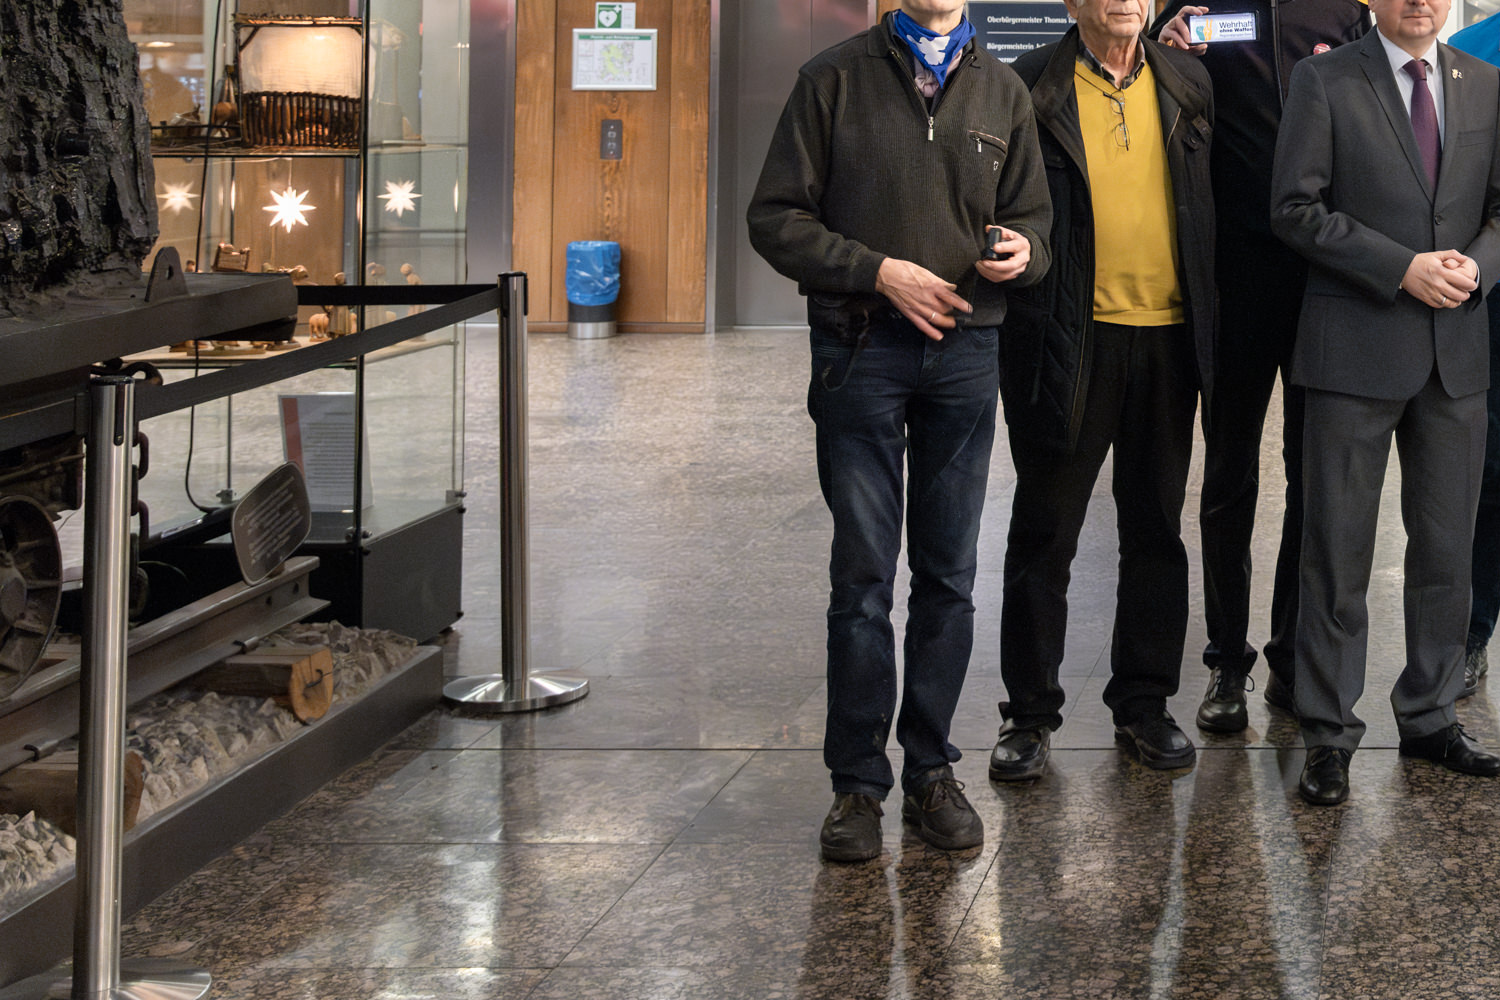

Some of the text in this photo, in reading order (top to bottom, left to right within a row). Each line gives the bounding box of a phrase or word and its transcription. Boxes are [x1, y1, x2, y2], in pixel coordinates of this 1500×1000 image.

[987, 16, 1043, 25] Oberbürgermeister
[1044, 16, 1067, 24] Thomas
[986, 42, 1034, 51] Bürgermeisterin
